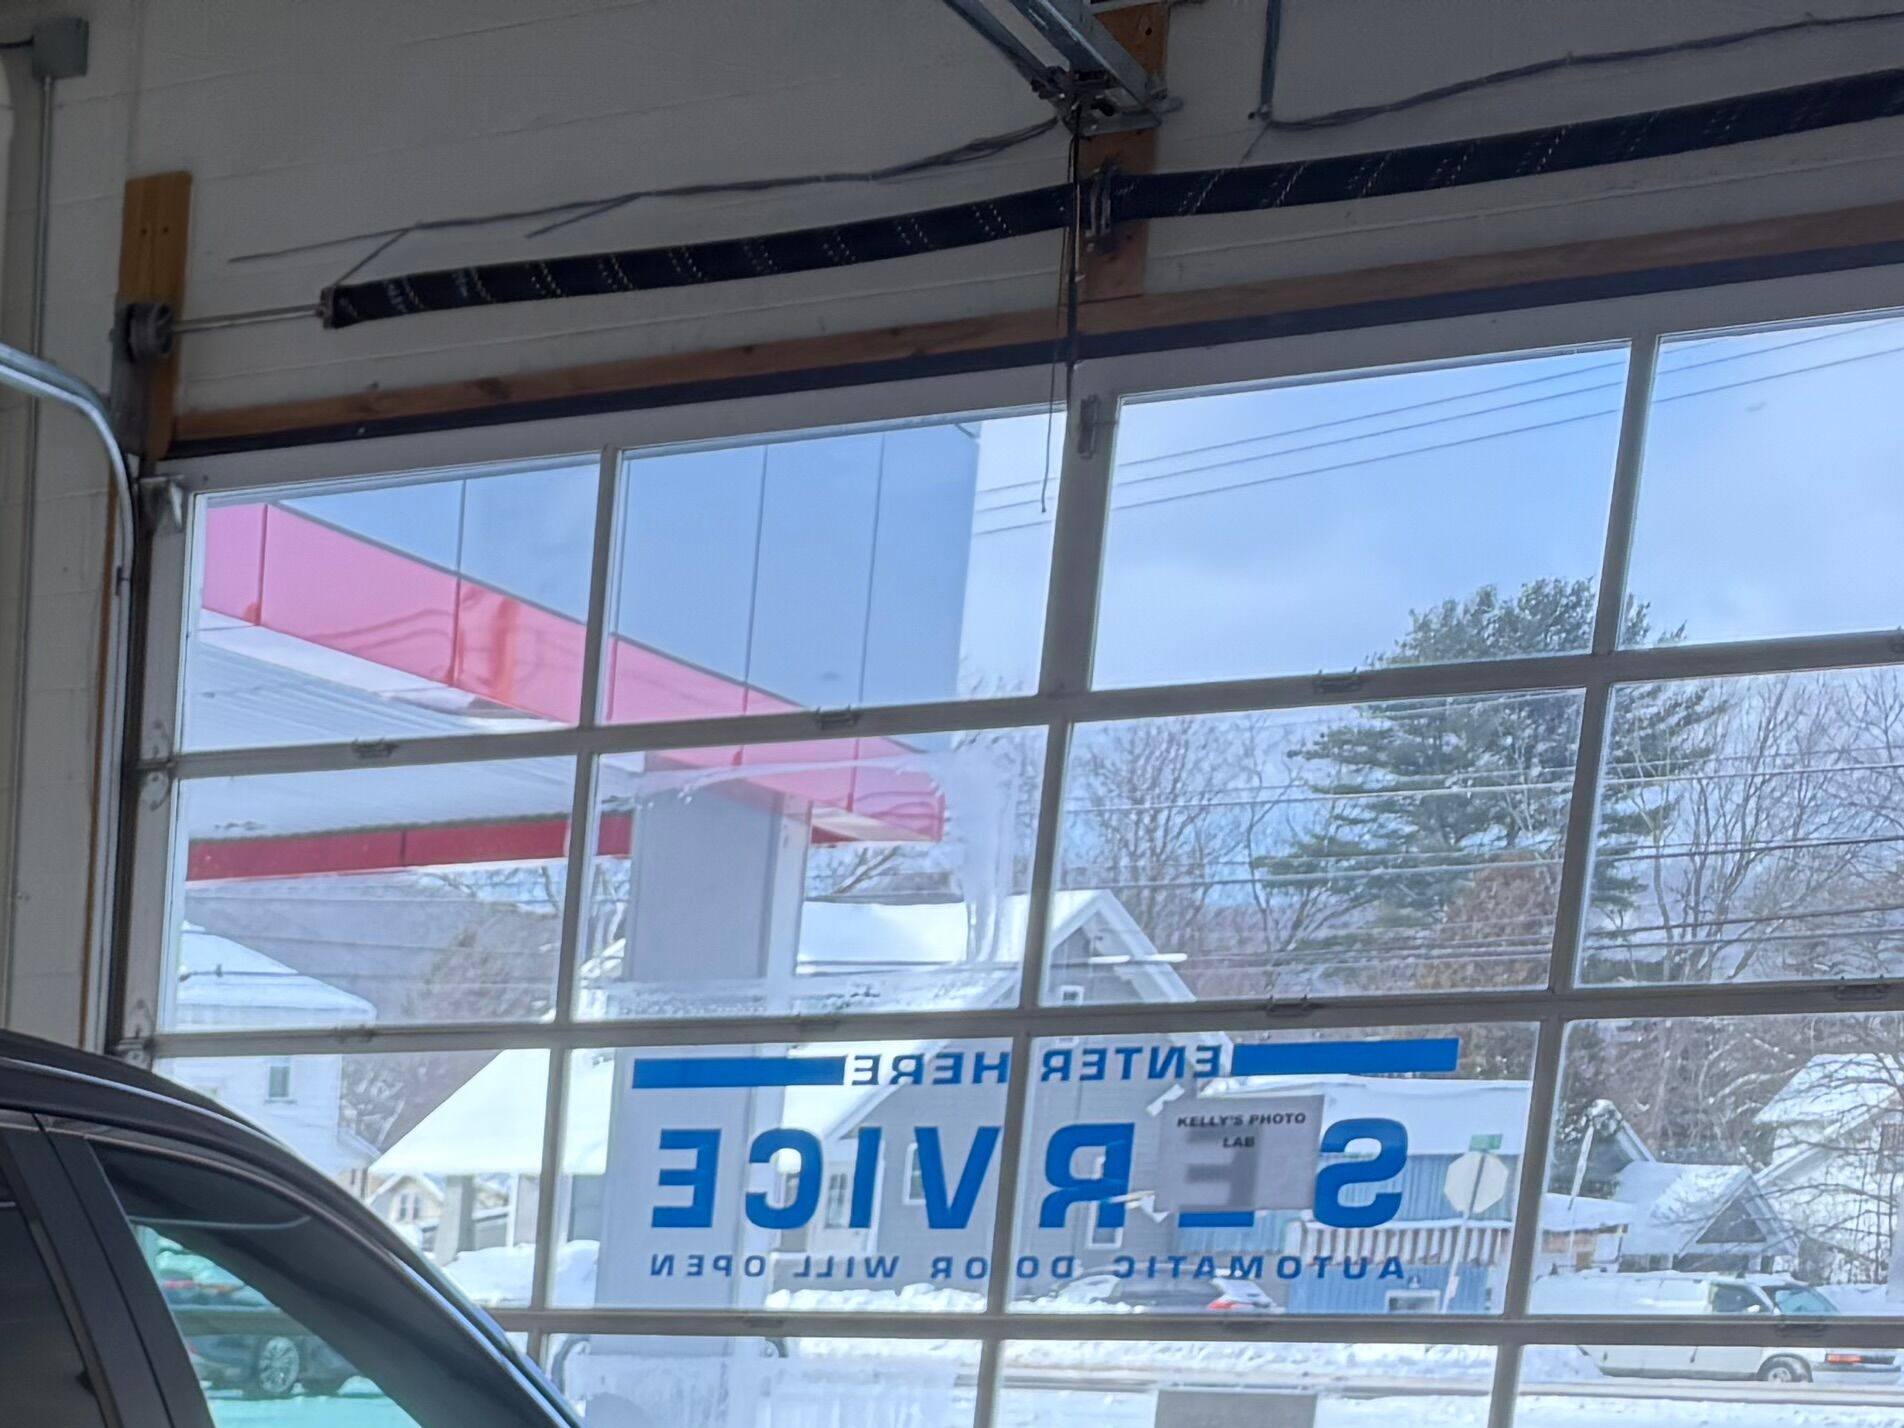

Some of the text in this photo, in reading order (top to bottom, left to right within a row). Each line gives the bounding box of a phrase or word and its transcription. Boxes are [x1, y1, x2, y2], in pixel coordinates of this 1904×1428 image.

[1177, 1112, 1306, 1128] KELLY'S PHOTO
[1222, 1136, 1256, 1149] LAB
